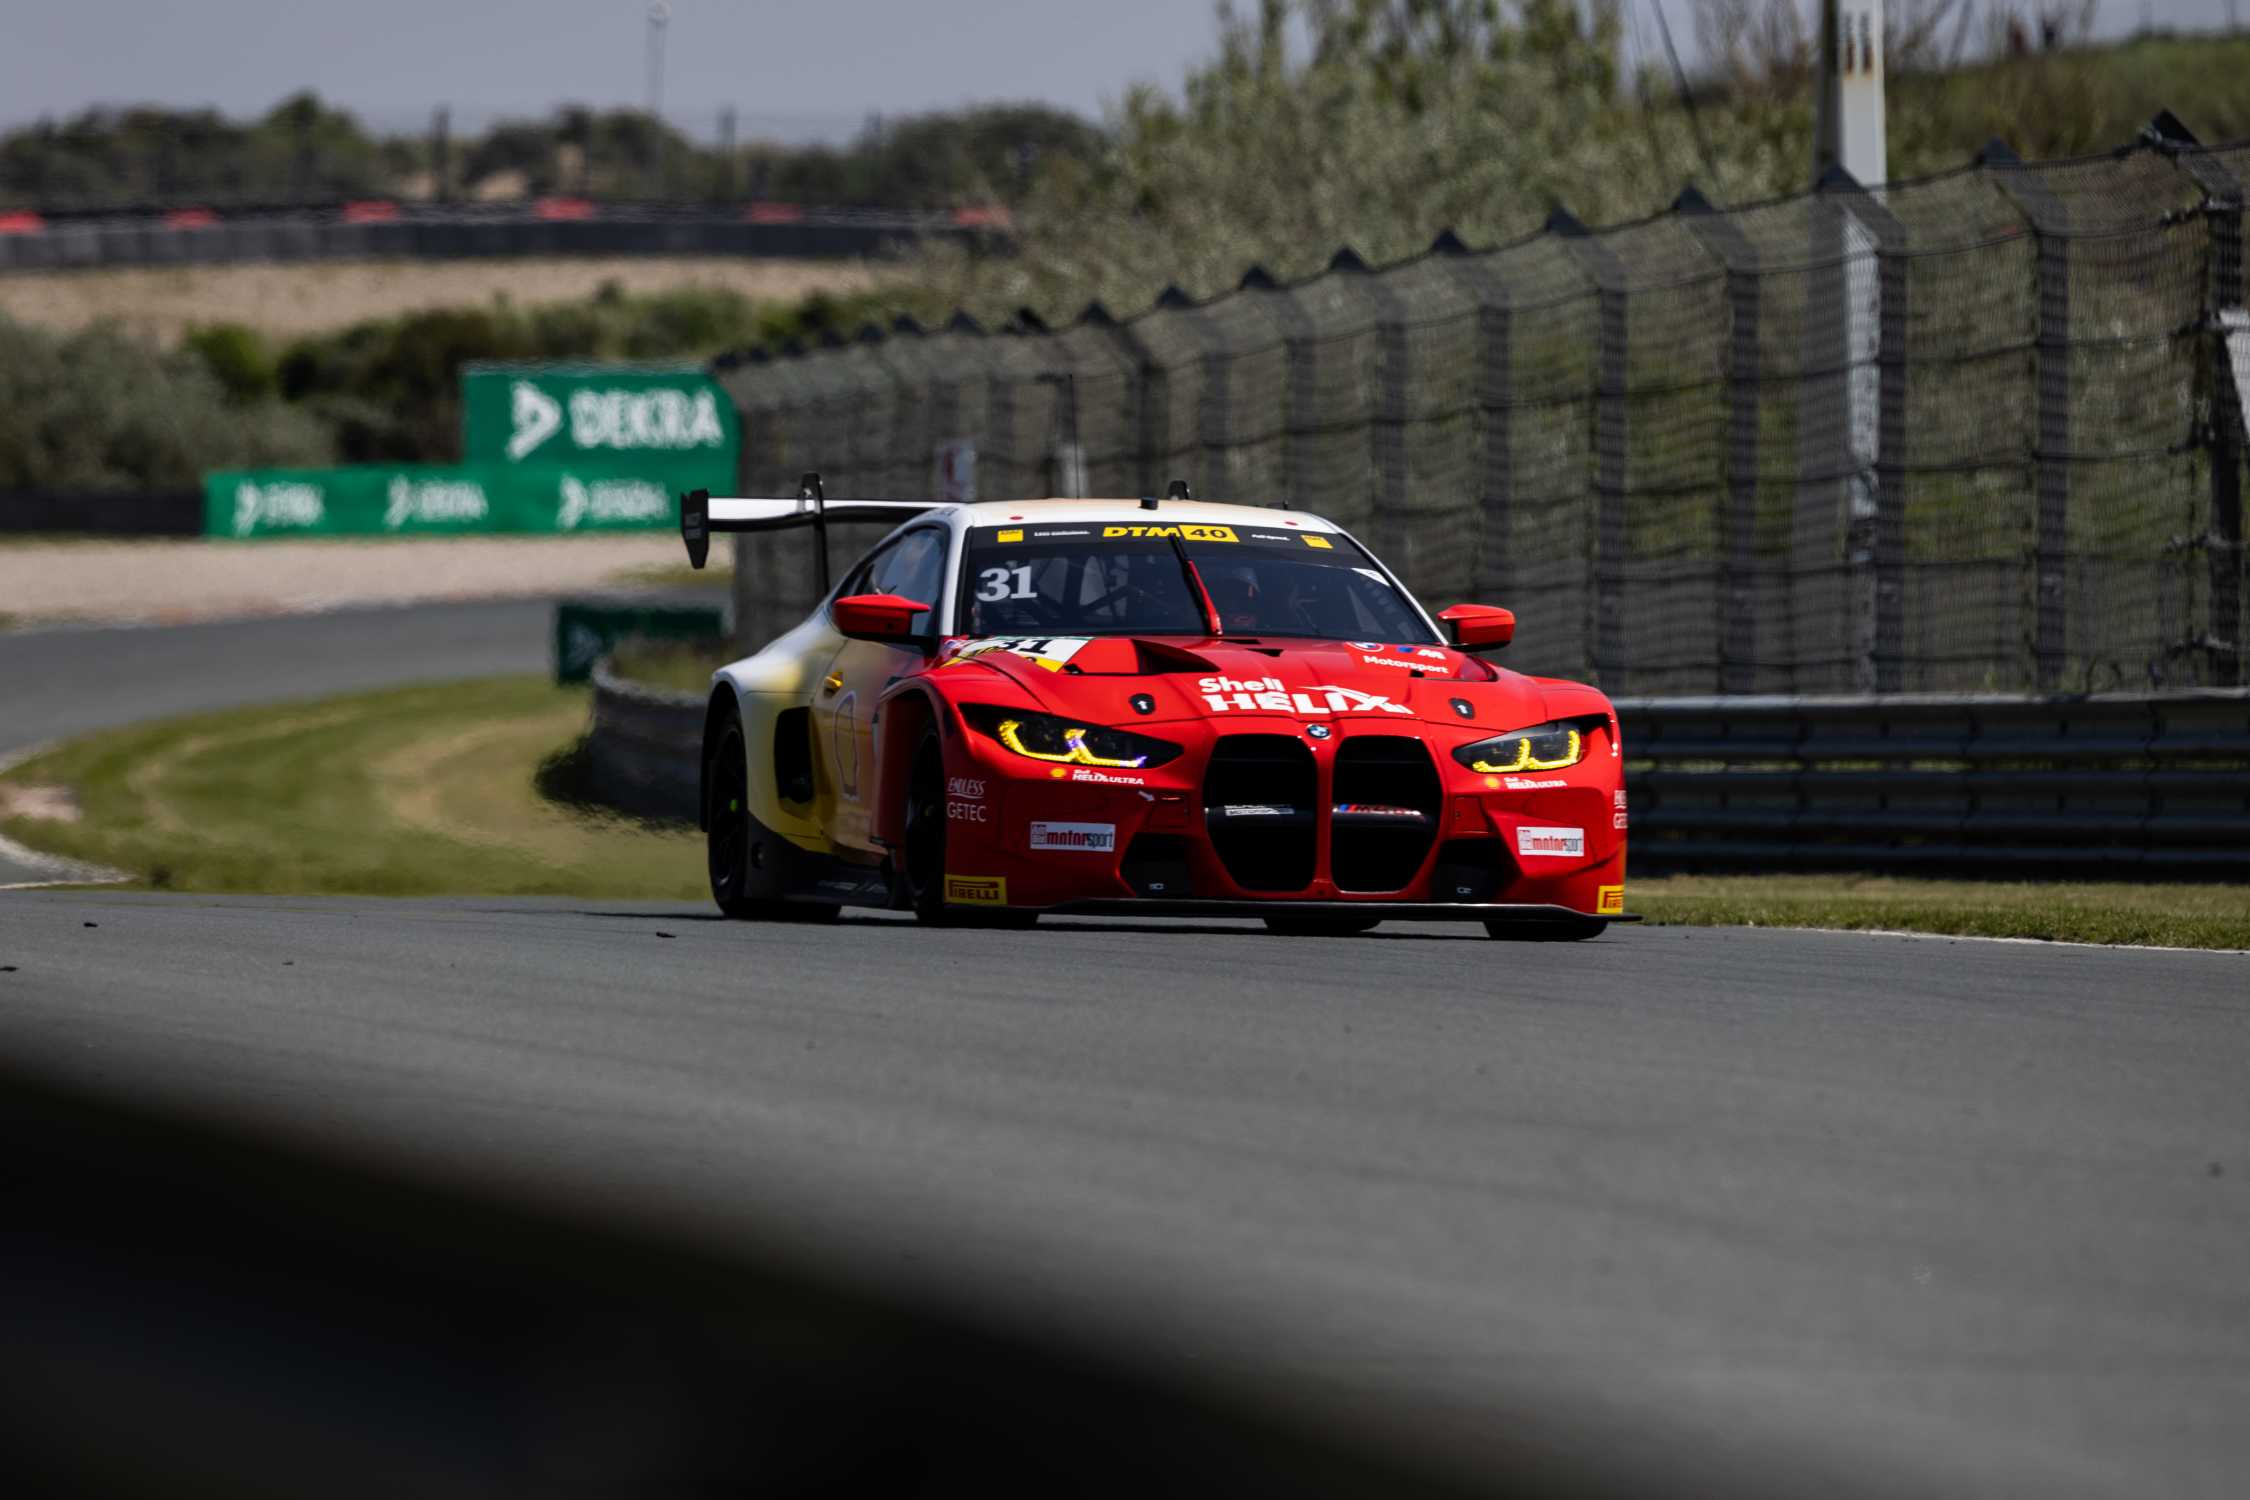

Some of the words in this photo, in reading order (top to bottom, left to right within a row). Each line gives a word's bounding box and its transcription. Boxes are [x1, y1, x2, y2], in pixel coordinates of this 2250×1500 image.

[569, 387, 724, 450] DEKRA
[1102, 526, 1181, 537] DTM
[1190, 529, 1228, 539] 40
[976, 565, 1038, 602] 31
[1363, 655, 1449, 674] Motorsport
[1198, 676, 1286, 693] Shell
[1201, 685, 1415, 715] HELIX
[946, 802, 987, 823] GETEC
[1046, 830, 1113, 849] motorsport
